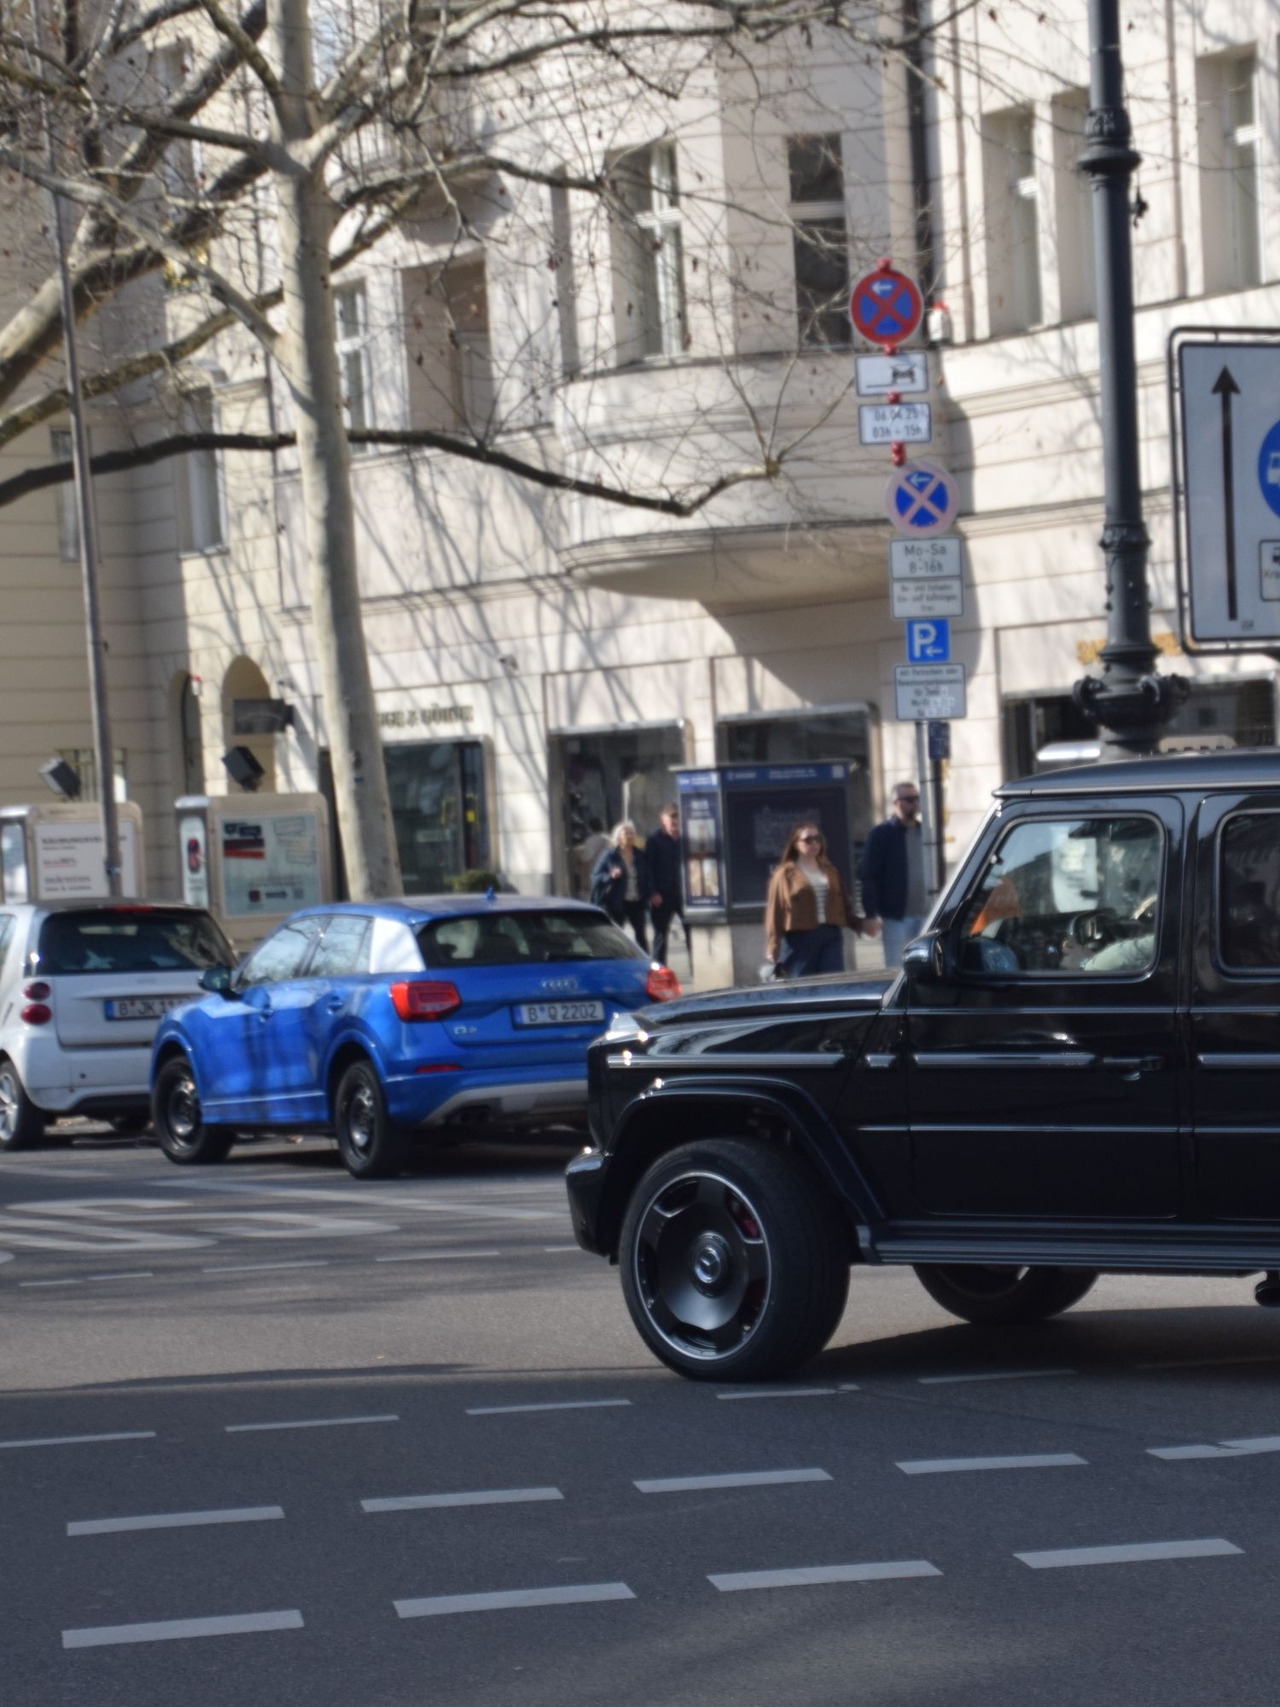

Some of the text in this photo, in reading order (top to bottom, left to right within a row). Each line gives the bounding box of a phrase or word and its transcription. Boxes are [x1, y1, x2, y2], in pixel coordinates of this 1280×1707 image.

[904, 544, 947, 556] Mo-Sa
[909, 560, 943, 574] 8-16h
[913, 623, 937, 658] P
[528, 1007, 538, 1023] B
[562, 1003, 598, 1020] 2202
